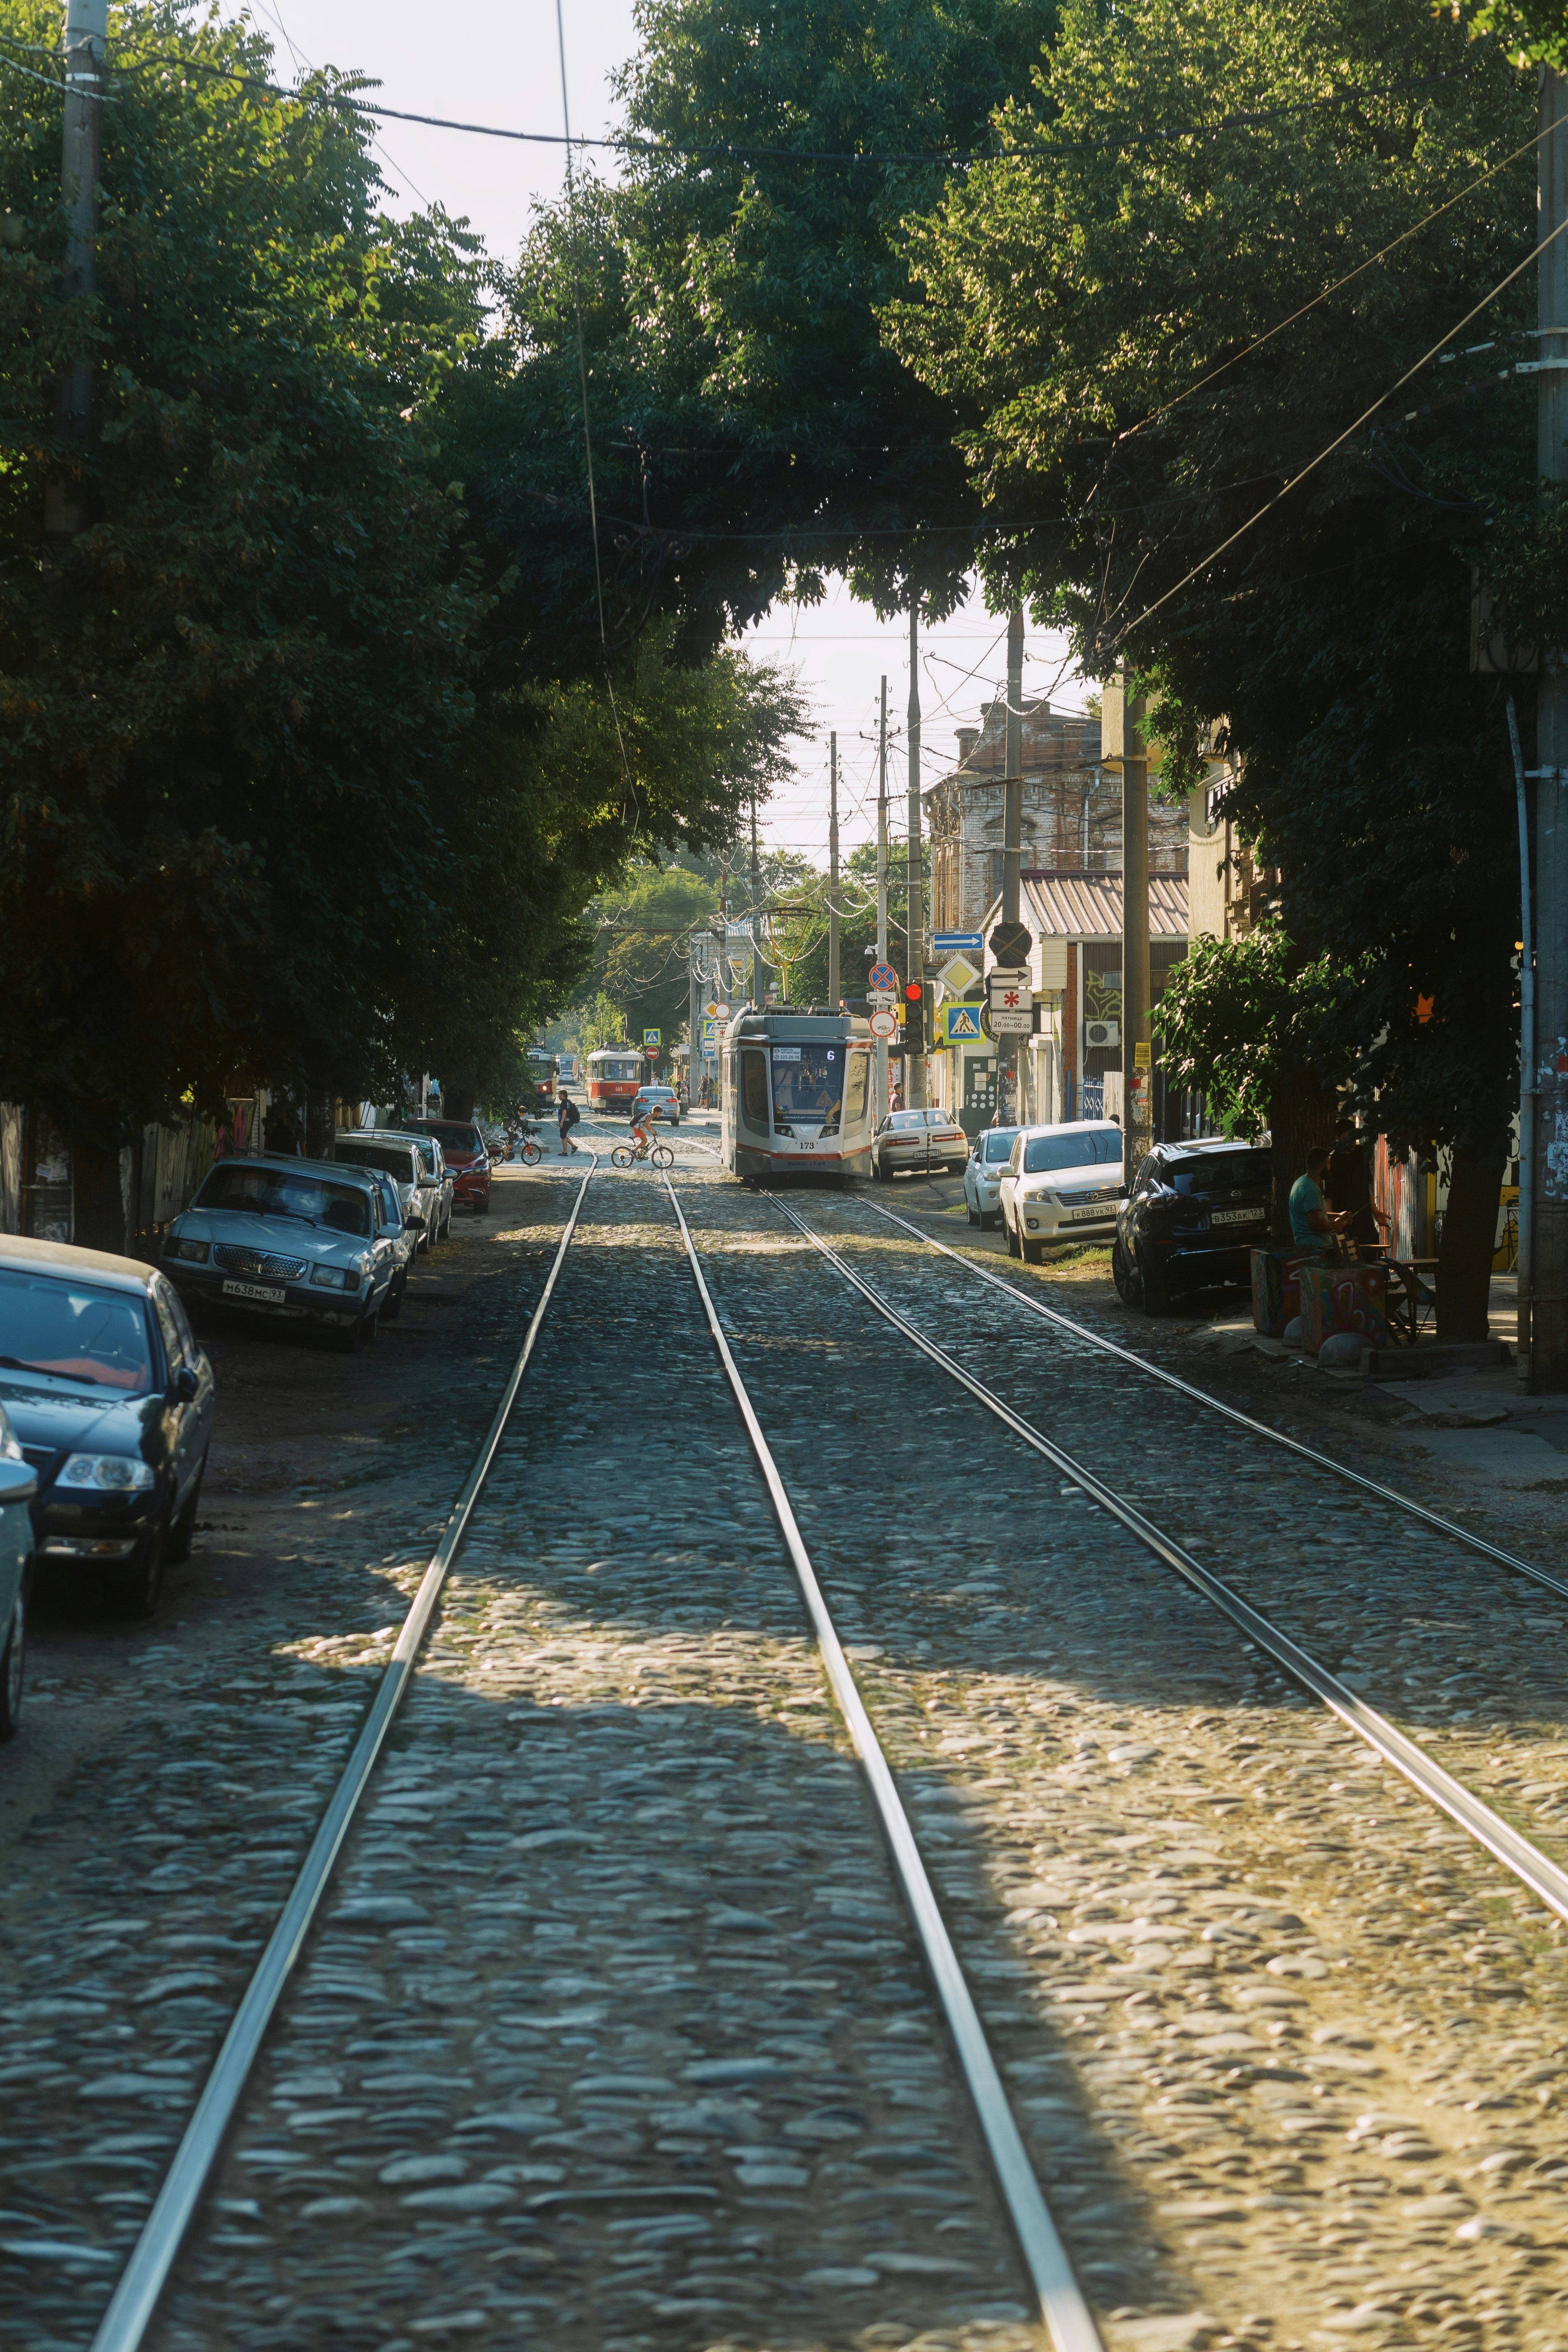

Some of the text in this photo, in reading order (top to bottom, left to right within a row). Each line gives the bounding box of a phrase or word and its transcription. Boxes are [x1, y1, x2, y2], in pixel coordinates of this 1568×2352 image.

[827, 1051, 835, 1060] 6
[1077, 1209, 1104, 1218] К888УК
[1215, 1212, 1248, 1222] В353АК
[227, 1284, 281, 1298] М638МС 93
